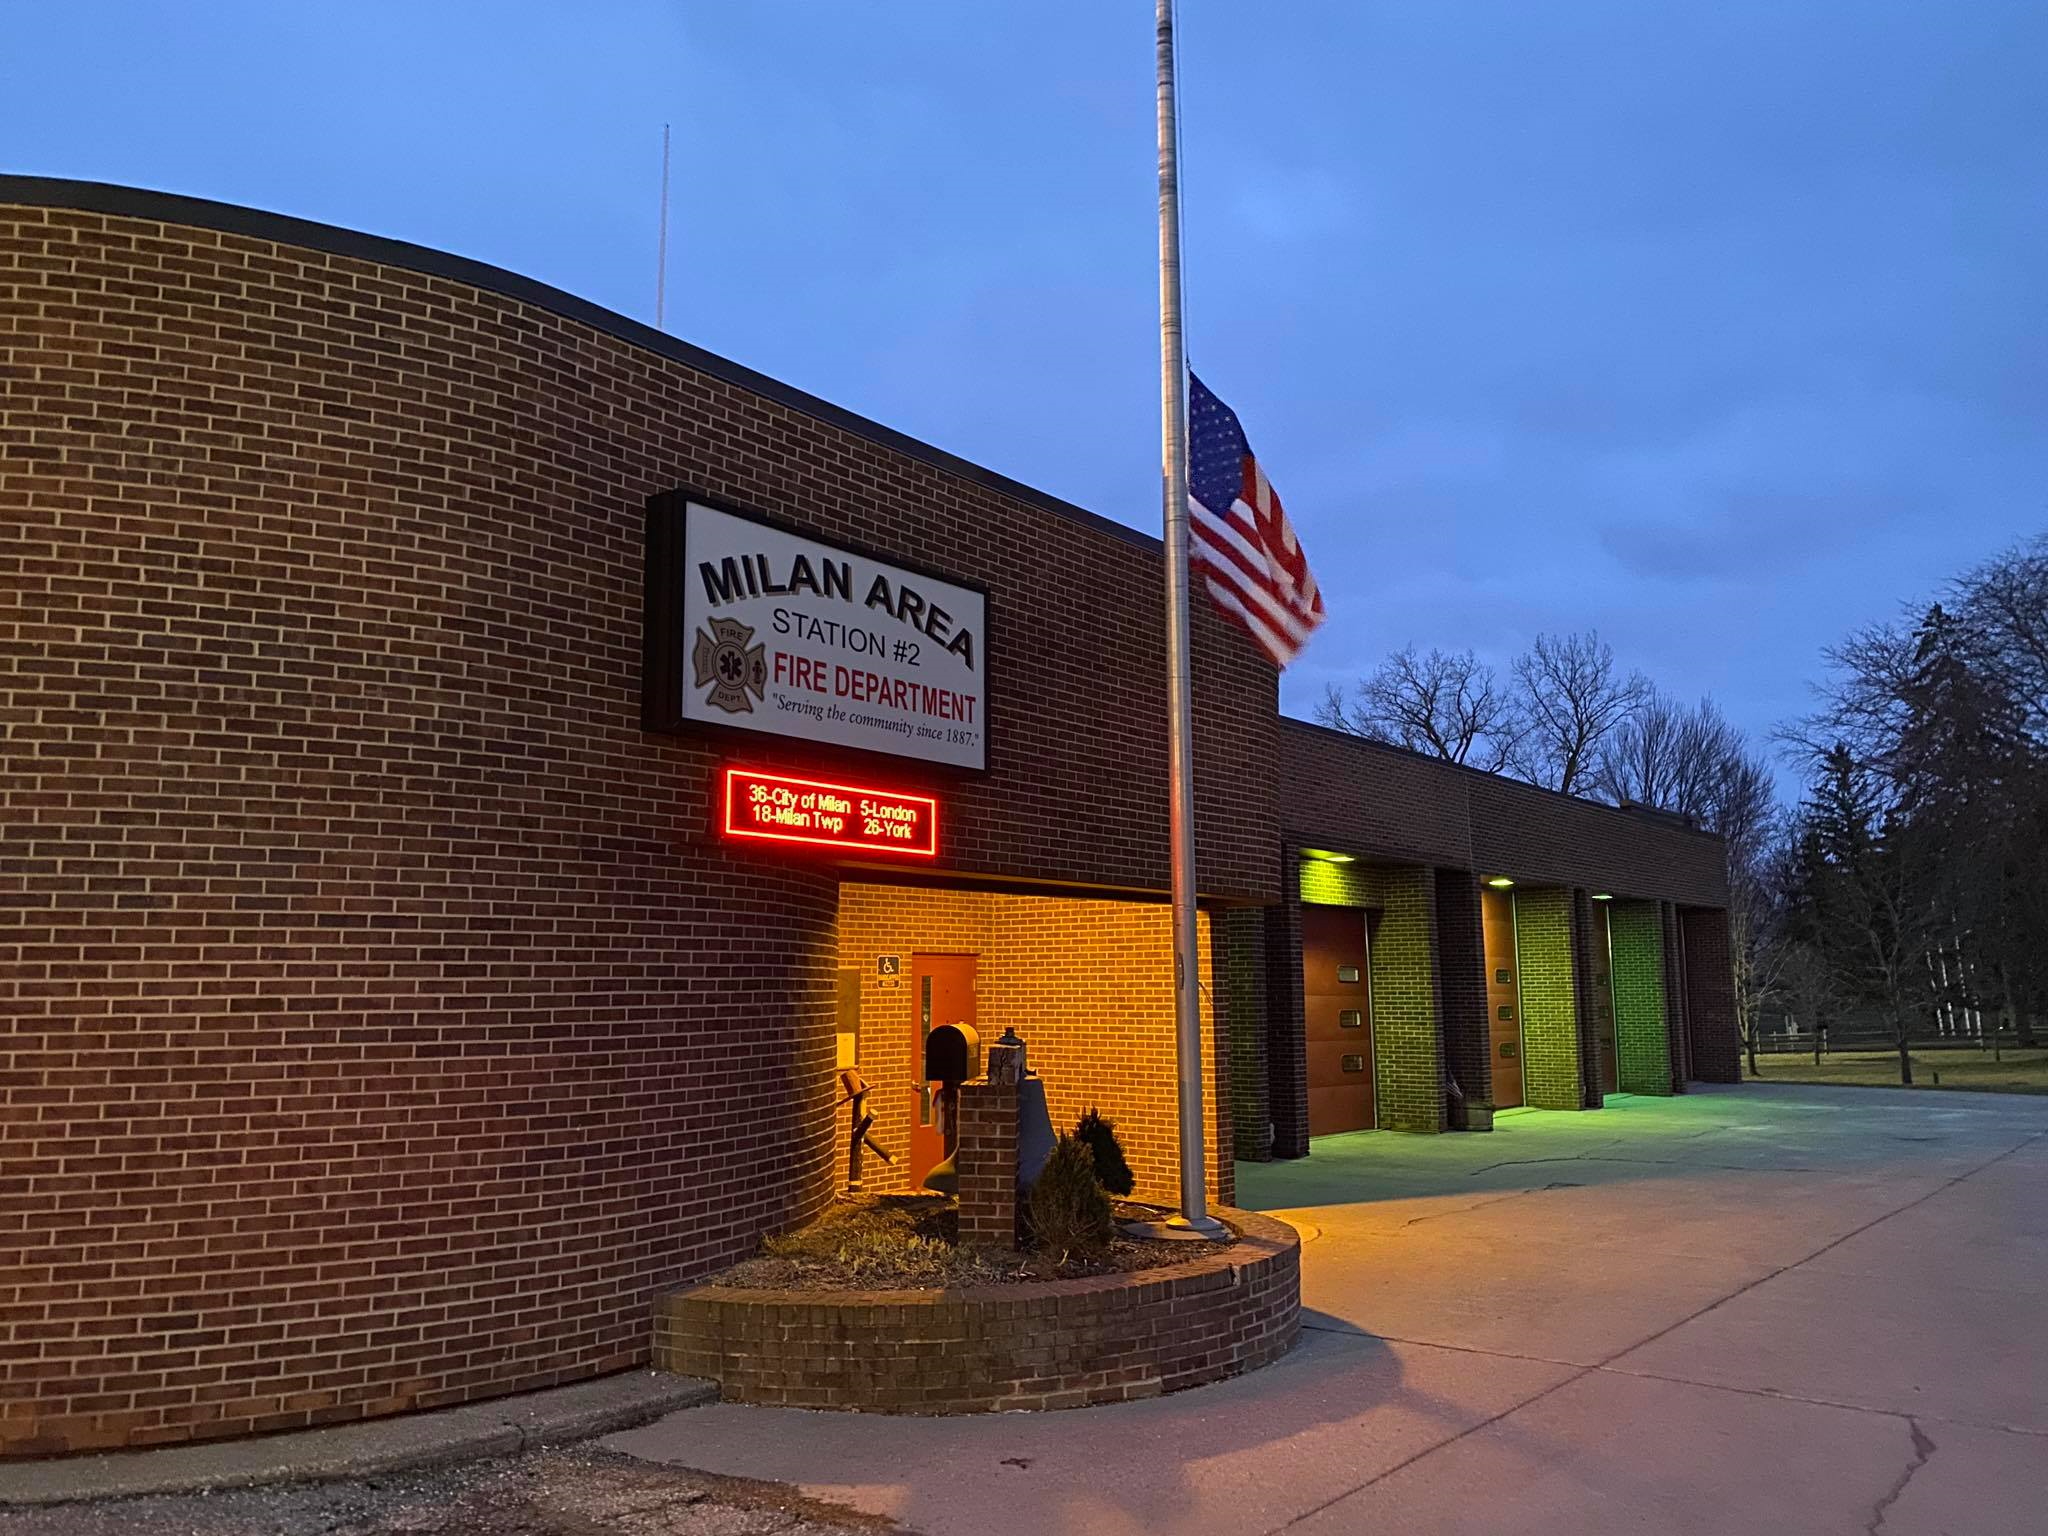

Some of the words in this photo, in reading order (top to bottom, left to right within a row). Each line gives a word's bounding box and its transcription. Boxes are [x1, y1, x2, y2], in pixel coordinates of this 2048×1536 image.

[698, 553, 852, 606] MILAN
[864, 574, 975, 672] AREA
[720, 628, 744, 641] FIRE
[772, 608, 886, 658] STATION
[893, 639, 921, 666] #2
[718, 691, 744, 703] DEPT.
[774, 652, 827, 693] FIRE
[835, 666, 977, 724] DEPARTMENT
[772, 692, 824, 722] "Serving
[827, 706, 846, 722] the
[849, 713, 914, 738] community
[916, 724, 943, 740] since
[946, 728, 980, 747] 1887."
[748, 784, 798, 808] 36-City
[801, 793, 816, 809] of
[818, 794, 851, 814] Milan
[860, 800, 917, 822] 5-London
[753, 804, 810, 828] 18-Milan
[813, 811, 843, 833] Twp
[863, 818, 912, 839] 26-York
